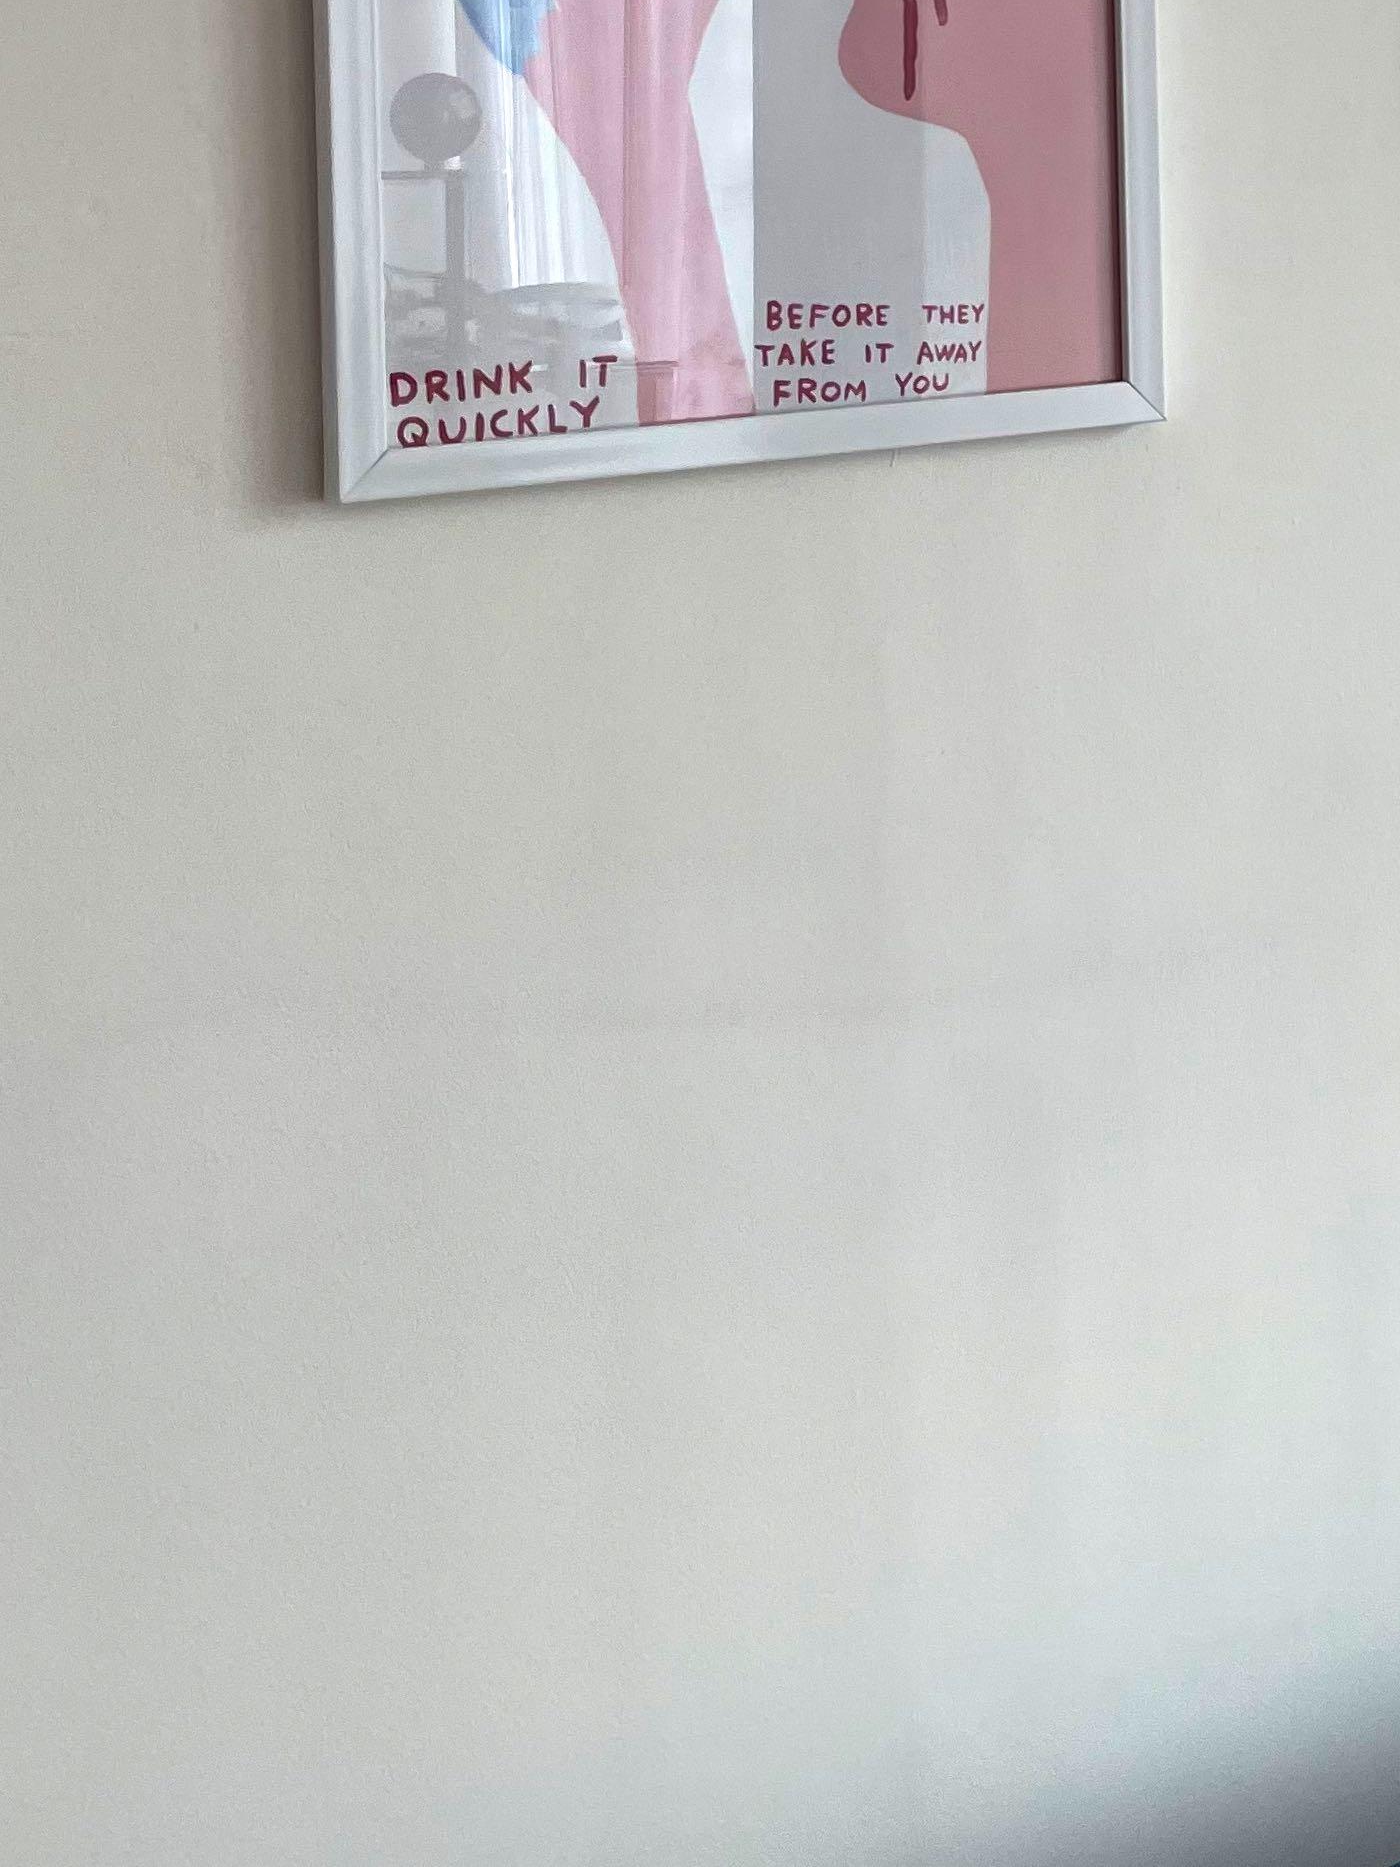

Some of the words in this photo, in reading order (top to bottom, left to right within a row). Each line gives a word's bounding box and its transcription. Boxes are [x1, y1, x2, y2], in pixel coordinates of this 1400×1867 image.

[765, 300, 890, 331] BEFORE
[922, 302, 986, 327] THEY
[754, 338, 836, 368] TAKE
[864, 341, 895, 365] IT
[916, 340, 982, 366] AWAY
[389, 358, 535, 408] DRINK
[578, 354, 619, 389] IT
[772, 378, 867, 406] FROM
[895, 371, 950, 397] YOU
[396, 396, 601, 448] QUICKLY
